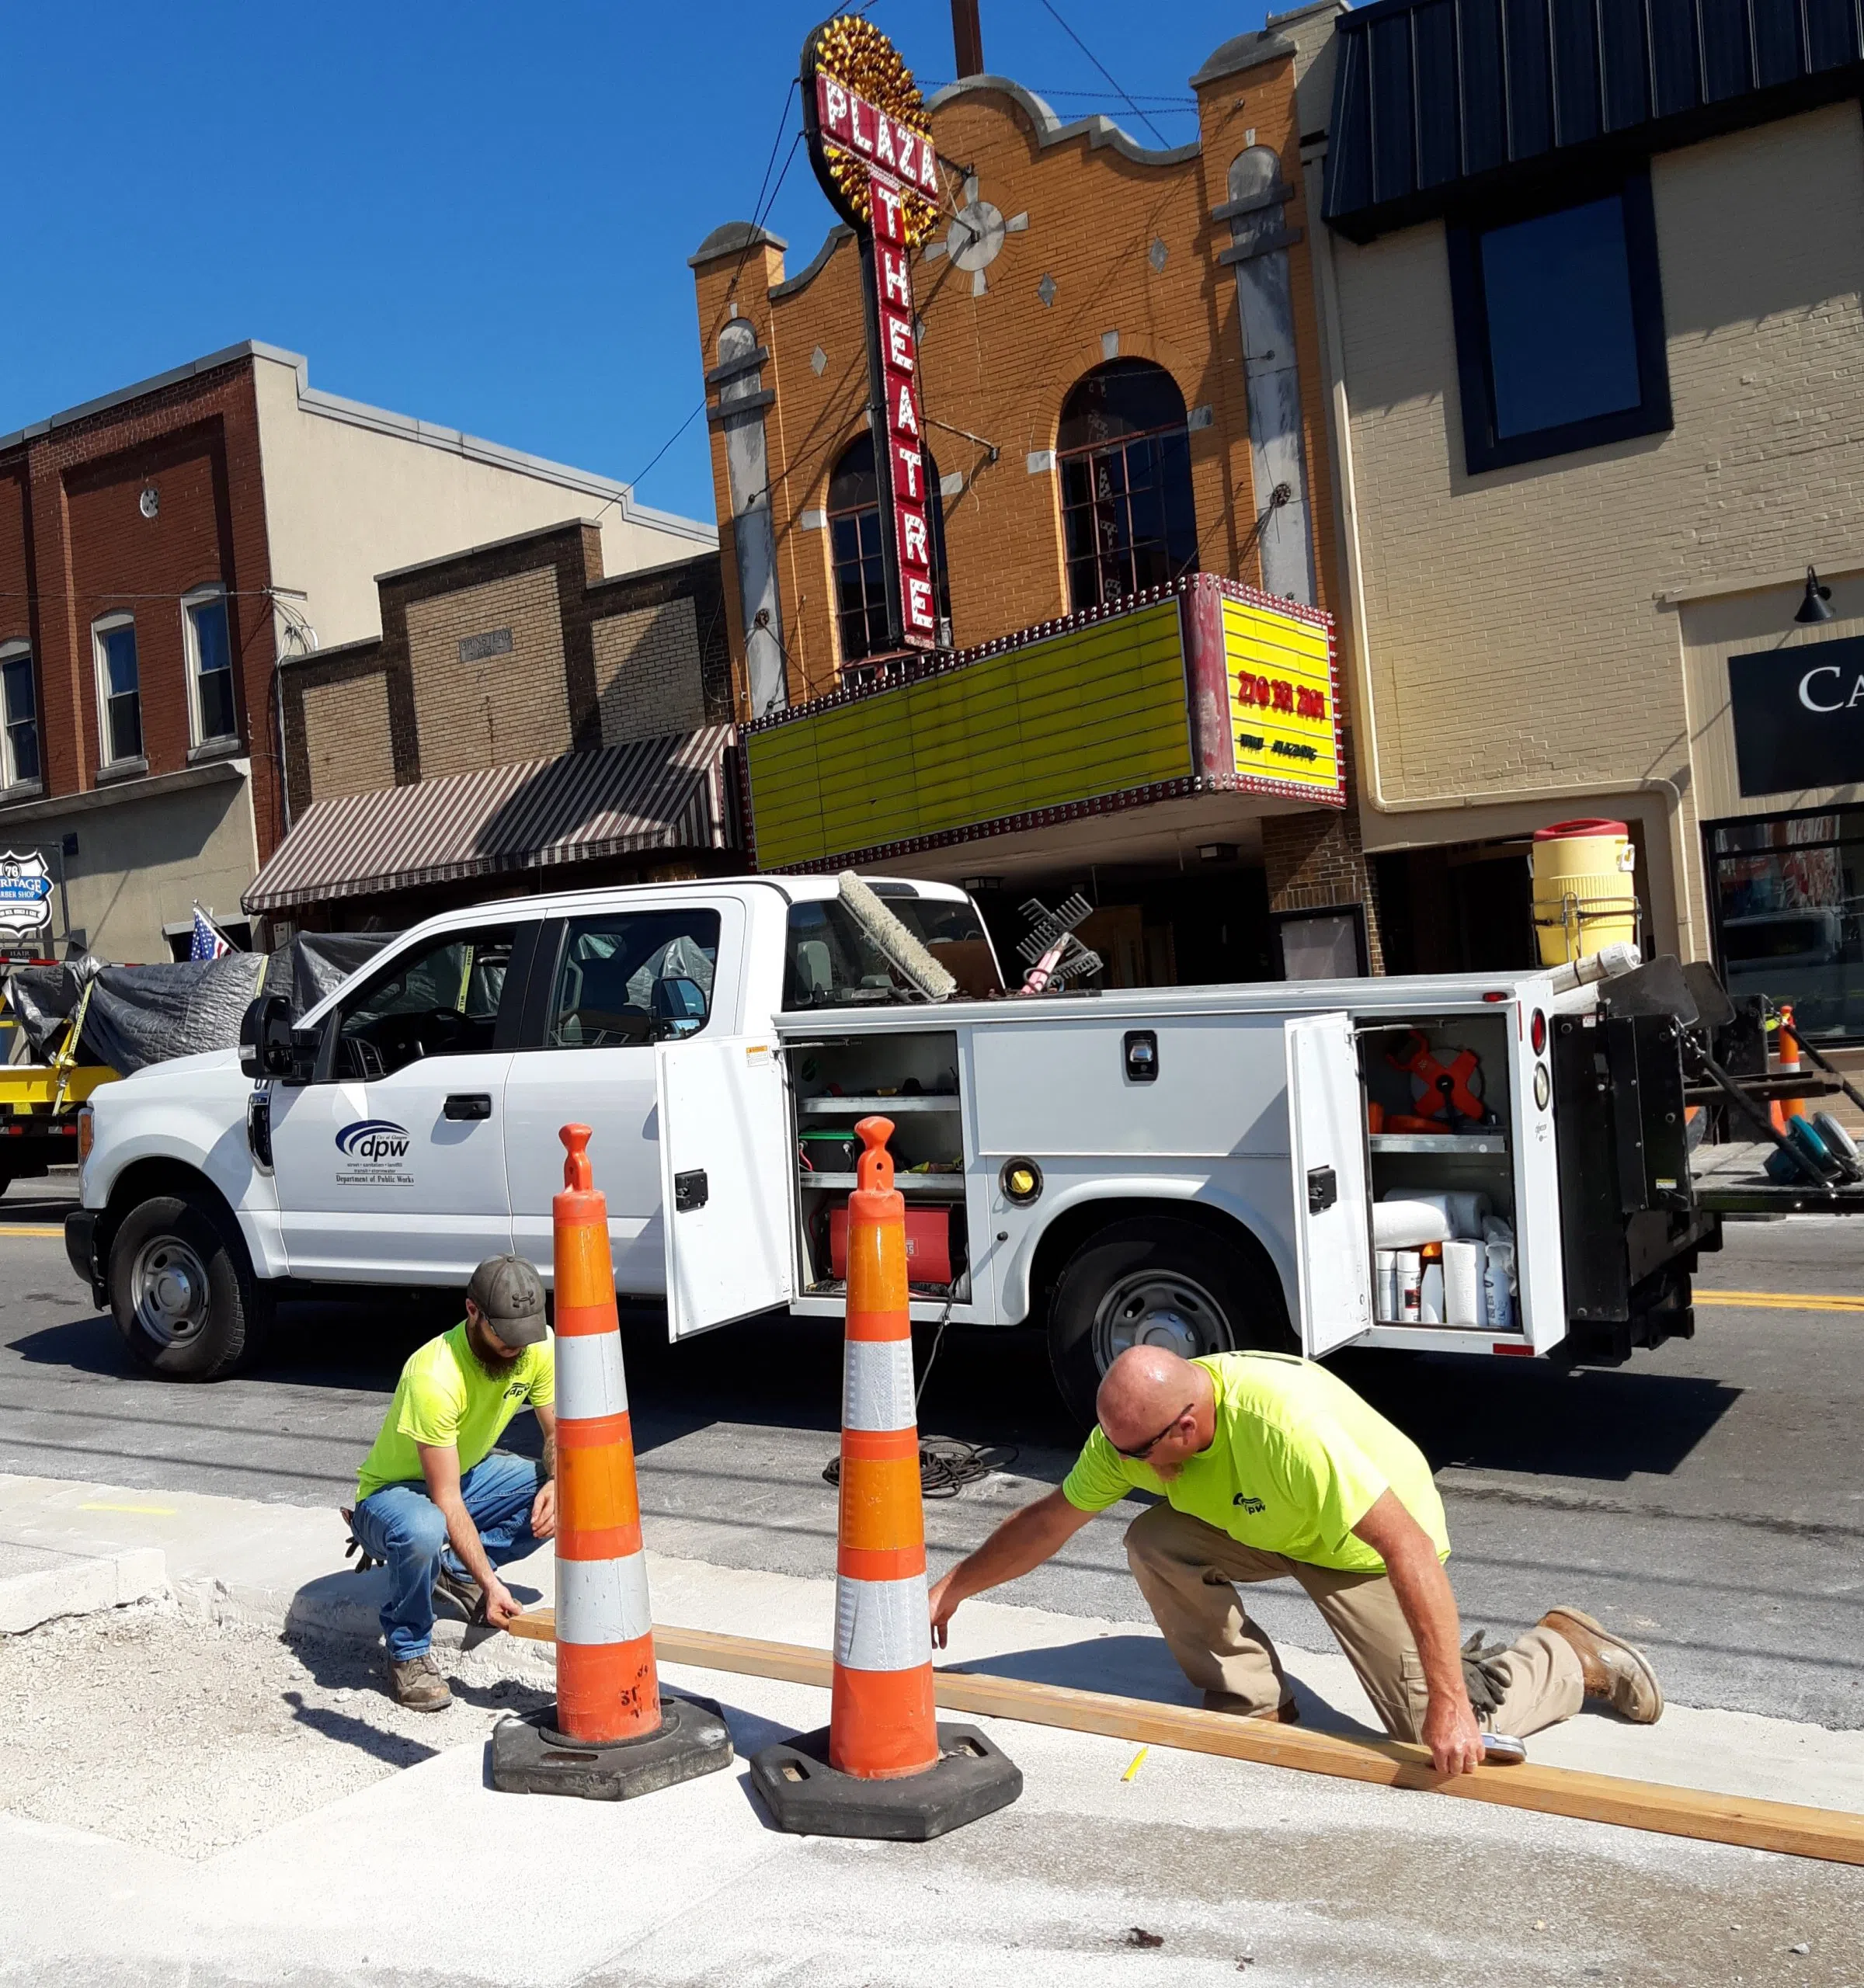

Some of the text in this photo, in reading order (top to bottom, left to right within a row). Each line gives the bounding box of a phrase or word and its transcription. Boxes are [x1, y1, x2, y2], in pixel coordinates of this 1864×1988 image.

[826, 80, 939, 194] PLAZA
[878, 186, 934, 629] THEATRE
[461, 631, 510, 651] GRINSTEAD
[5, 865, 19, 878] 76
[360, 1135, 411, 1163] dpw
[336, 1175, 368, 1184] Department
[1244, 1504, 1266, 1515] pw
